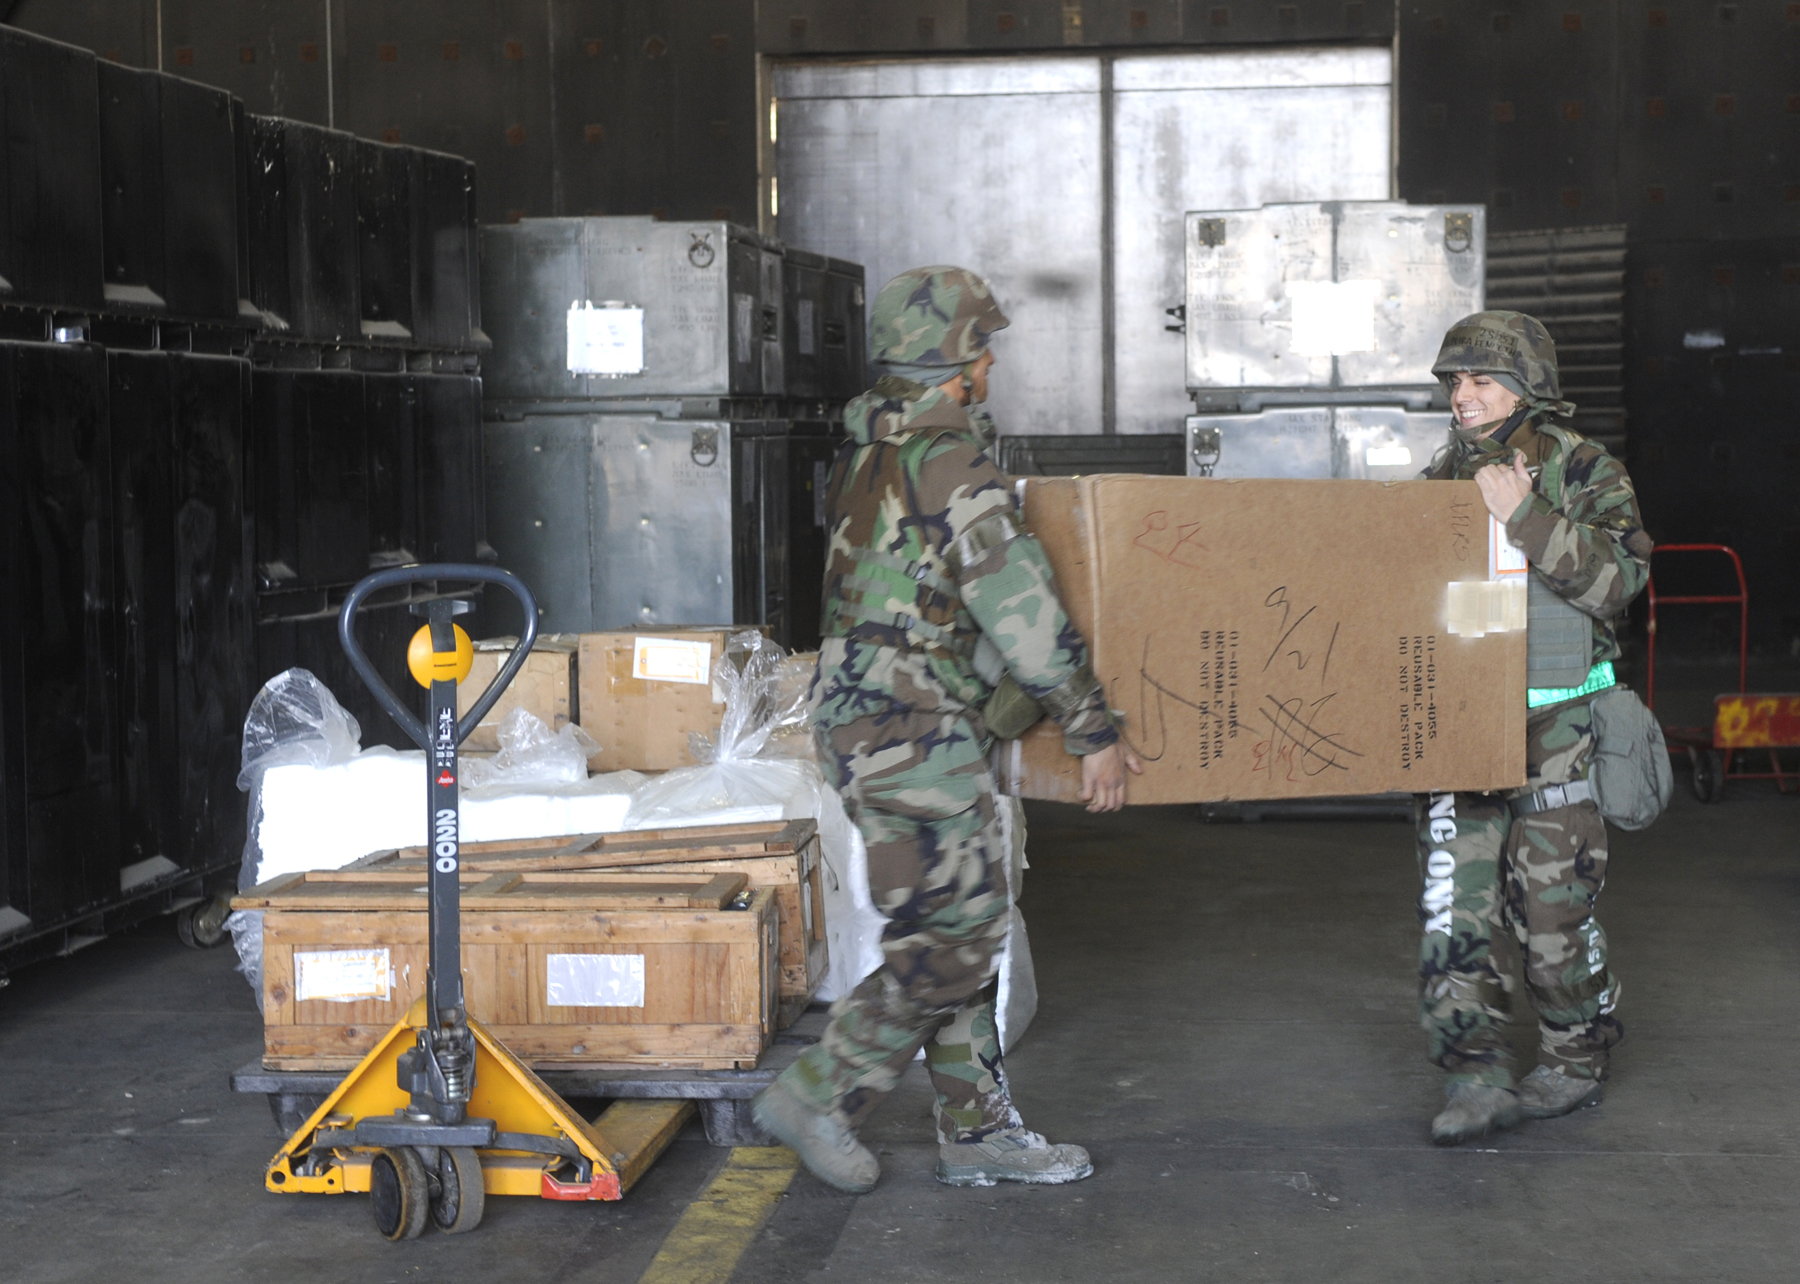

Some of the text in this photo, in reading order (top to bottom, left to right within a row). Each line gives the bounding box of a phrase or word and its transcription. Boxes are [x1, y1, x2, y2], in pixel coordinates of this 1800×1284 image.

[1198, 630, 1210, 771] DO NOT DESTROY
[1213, 630, 1225, 760] REUSABLE PACK
[1399, 636, 1410, 771] DO NOT DESTROY
[1413, 635, 1424, 761] REUSABLE PACK
[1426, 635, 1437, 740] 01-031-4055
[435, 808, 458, 874] 2200
